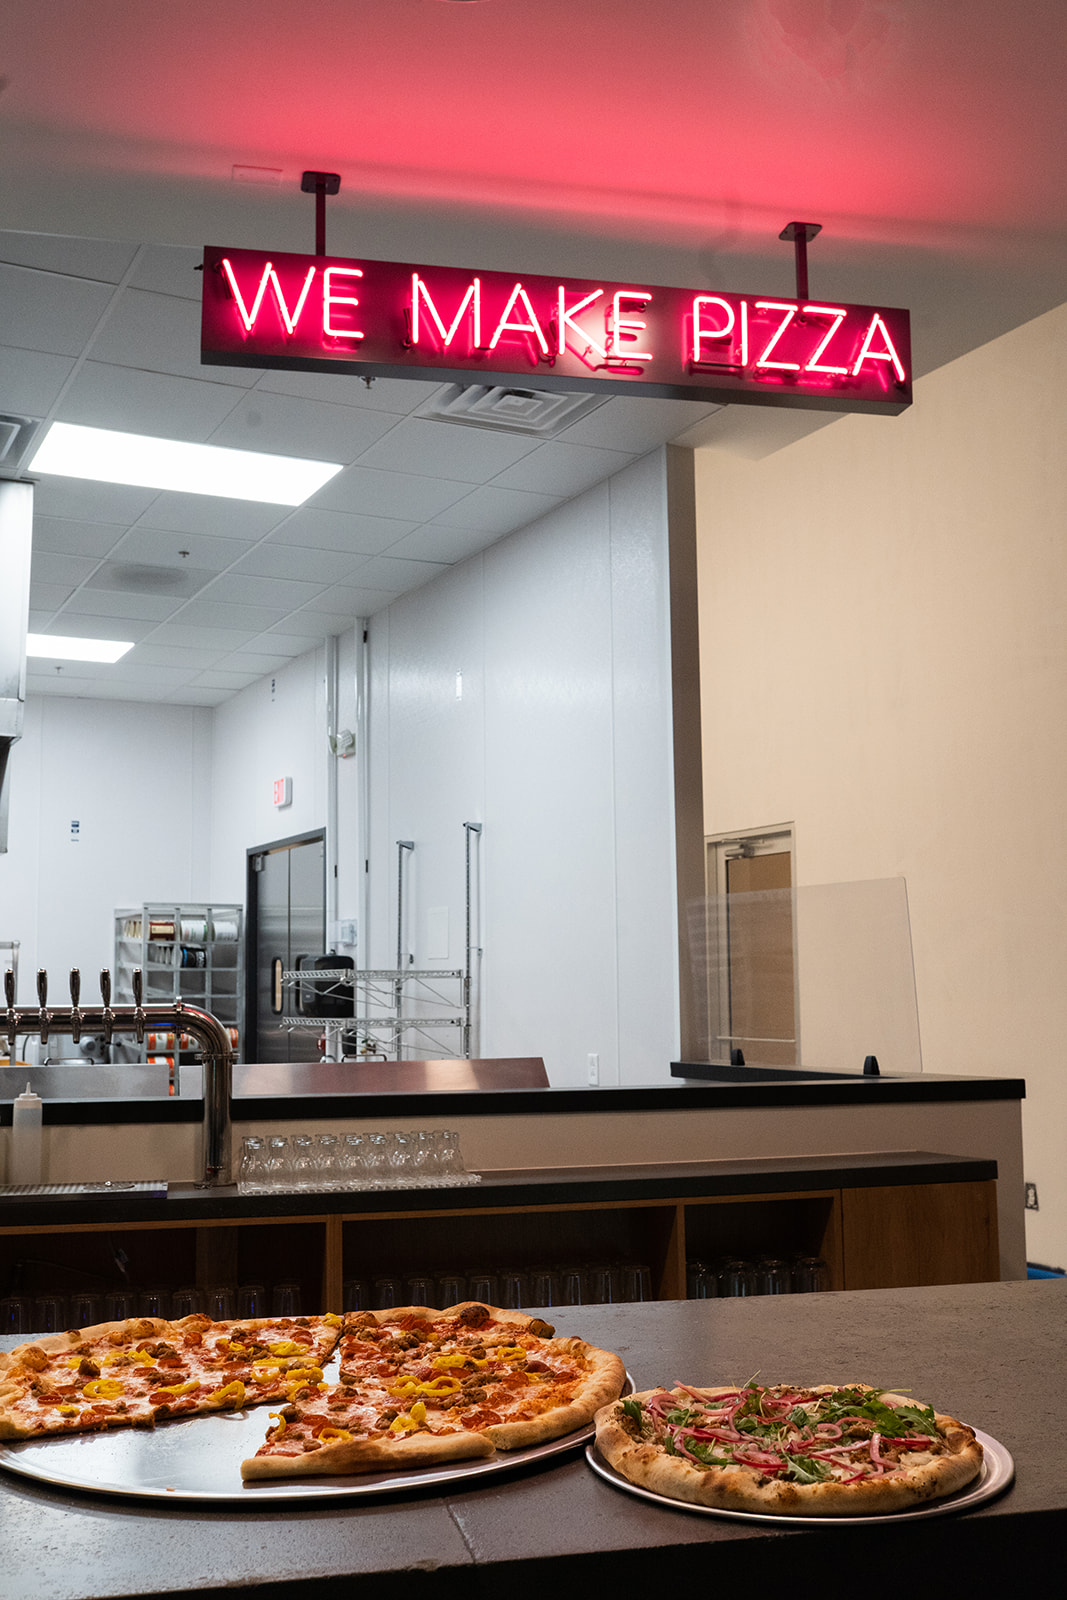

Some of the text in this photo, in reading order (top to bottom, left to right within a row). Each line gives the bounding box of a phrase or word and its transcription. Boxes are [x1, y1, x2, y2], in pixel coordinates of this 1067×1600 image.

[221, 257, 906, 383] WE MAKE PIZZA
